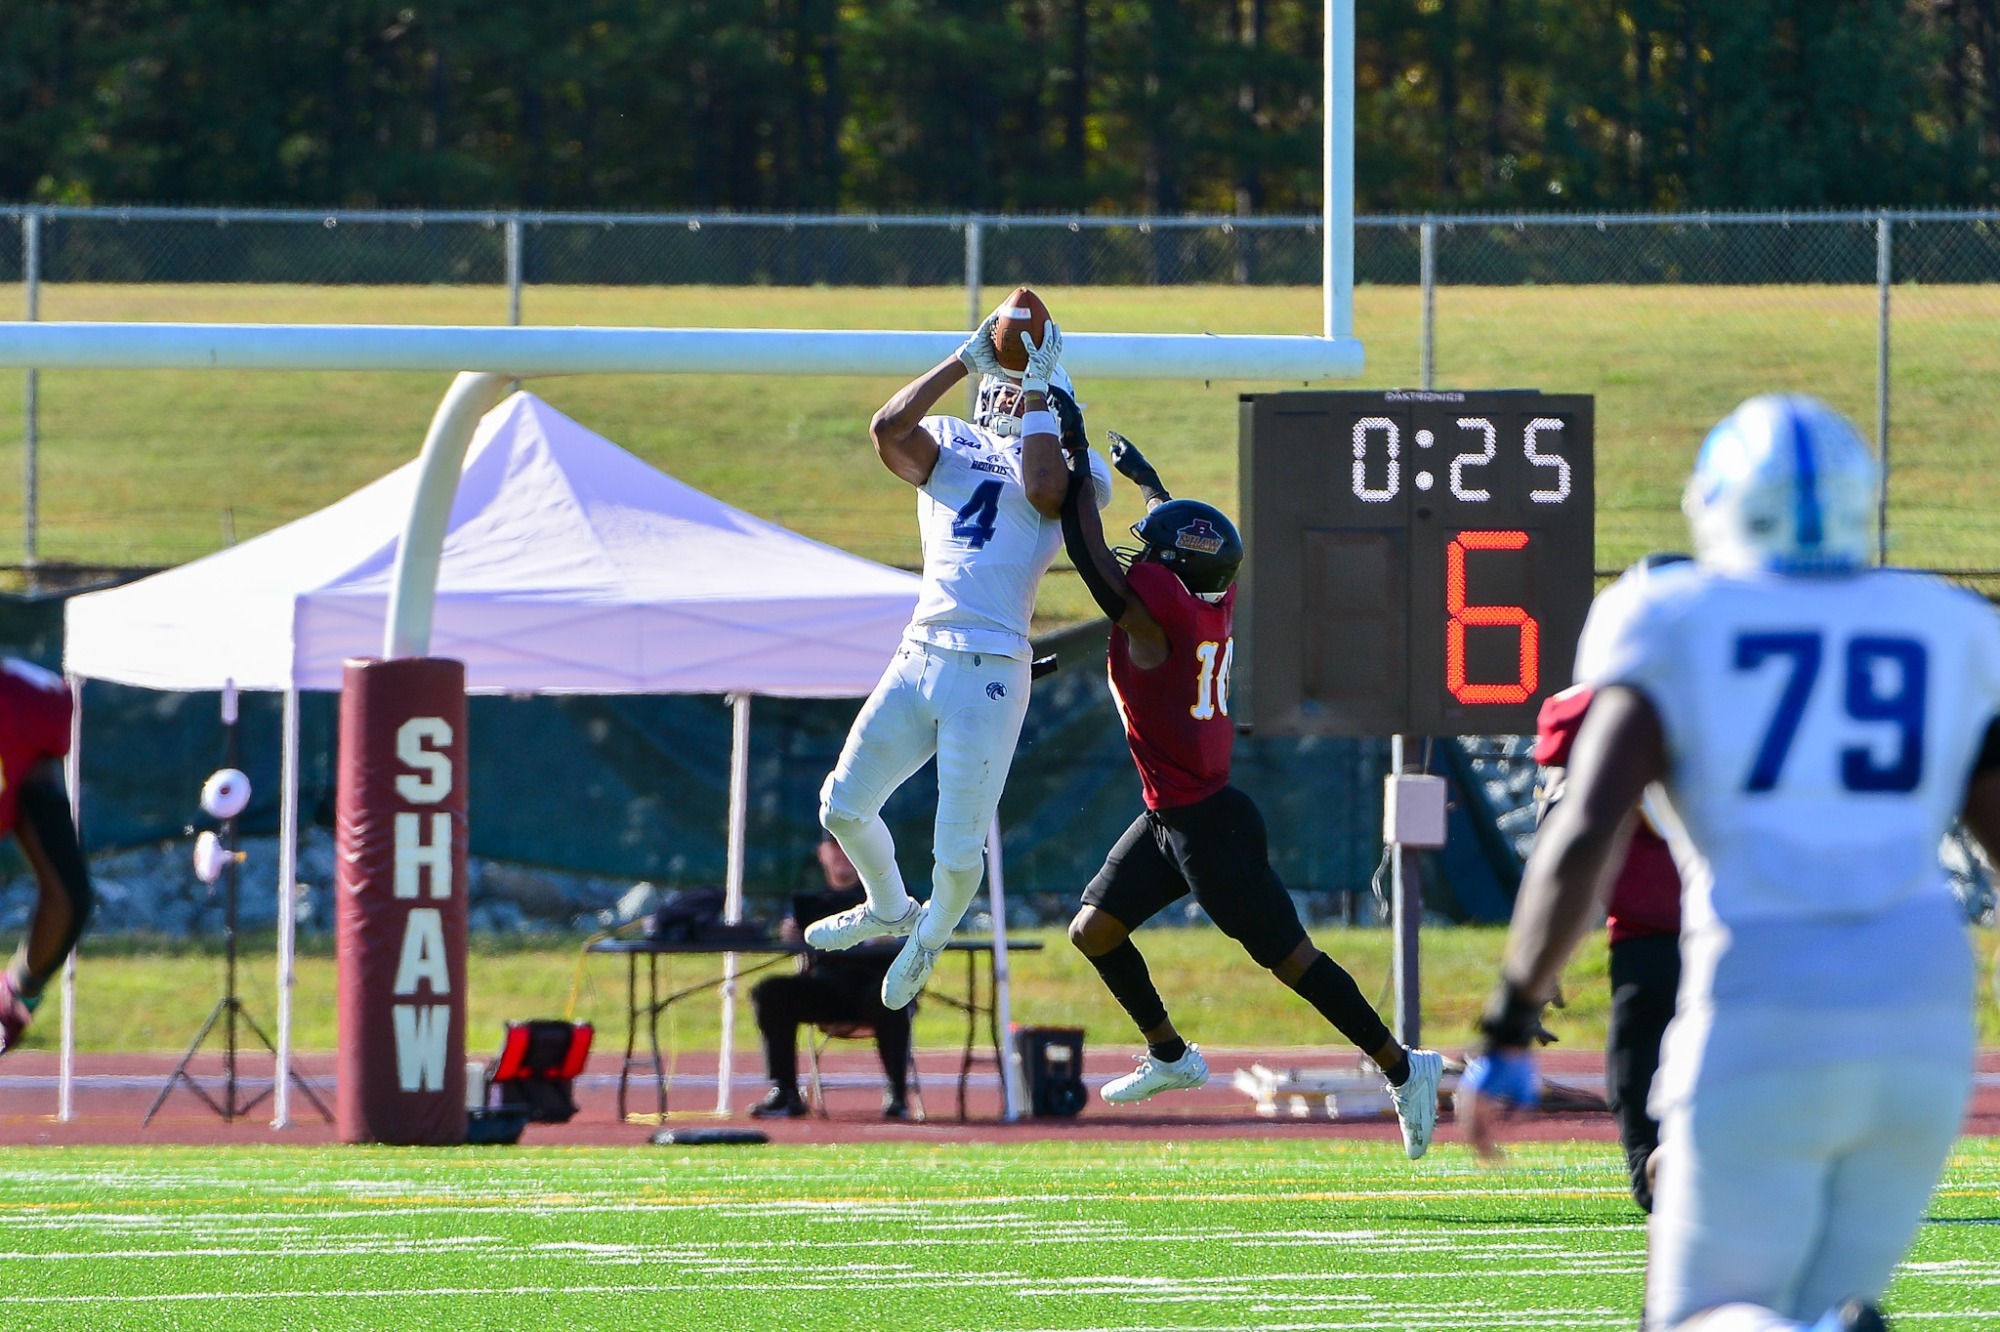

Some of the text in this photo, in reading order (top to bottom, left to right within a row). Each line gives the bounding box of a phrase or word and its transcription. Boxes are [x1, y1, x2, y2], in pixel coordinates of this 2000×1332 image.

[951, 479, 1004, 549] 4
[1352, 417, 1571, 503] 0:25
[1446, 531, 1539, 704] 6
[1732, 630, 1928, 793] 79
[393, 717, 453, 1092] SHAW
